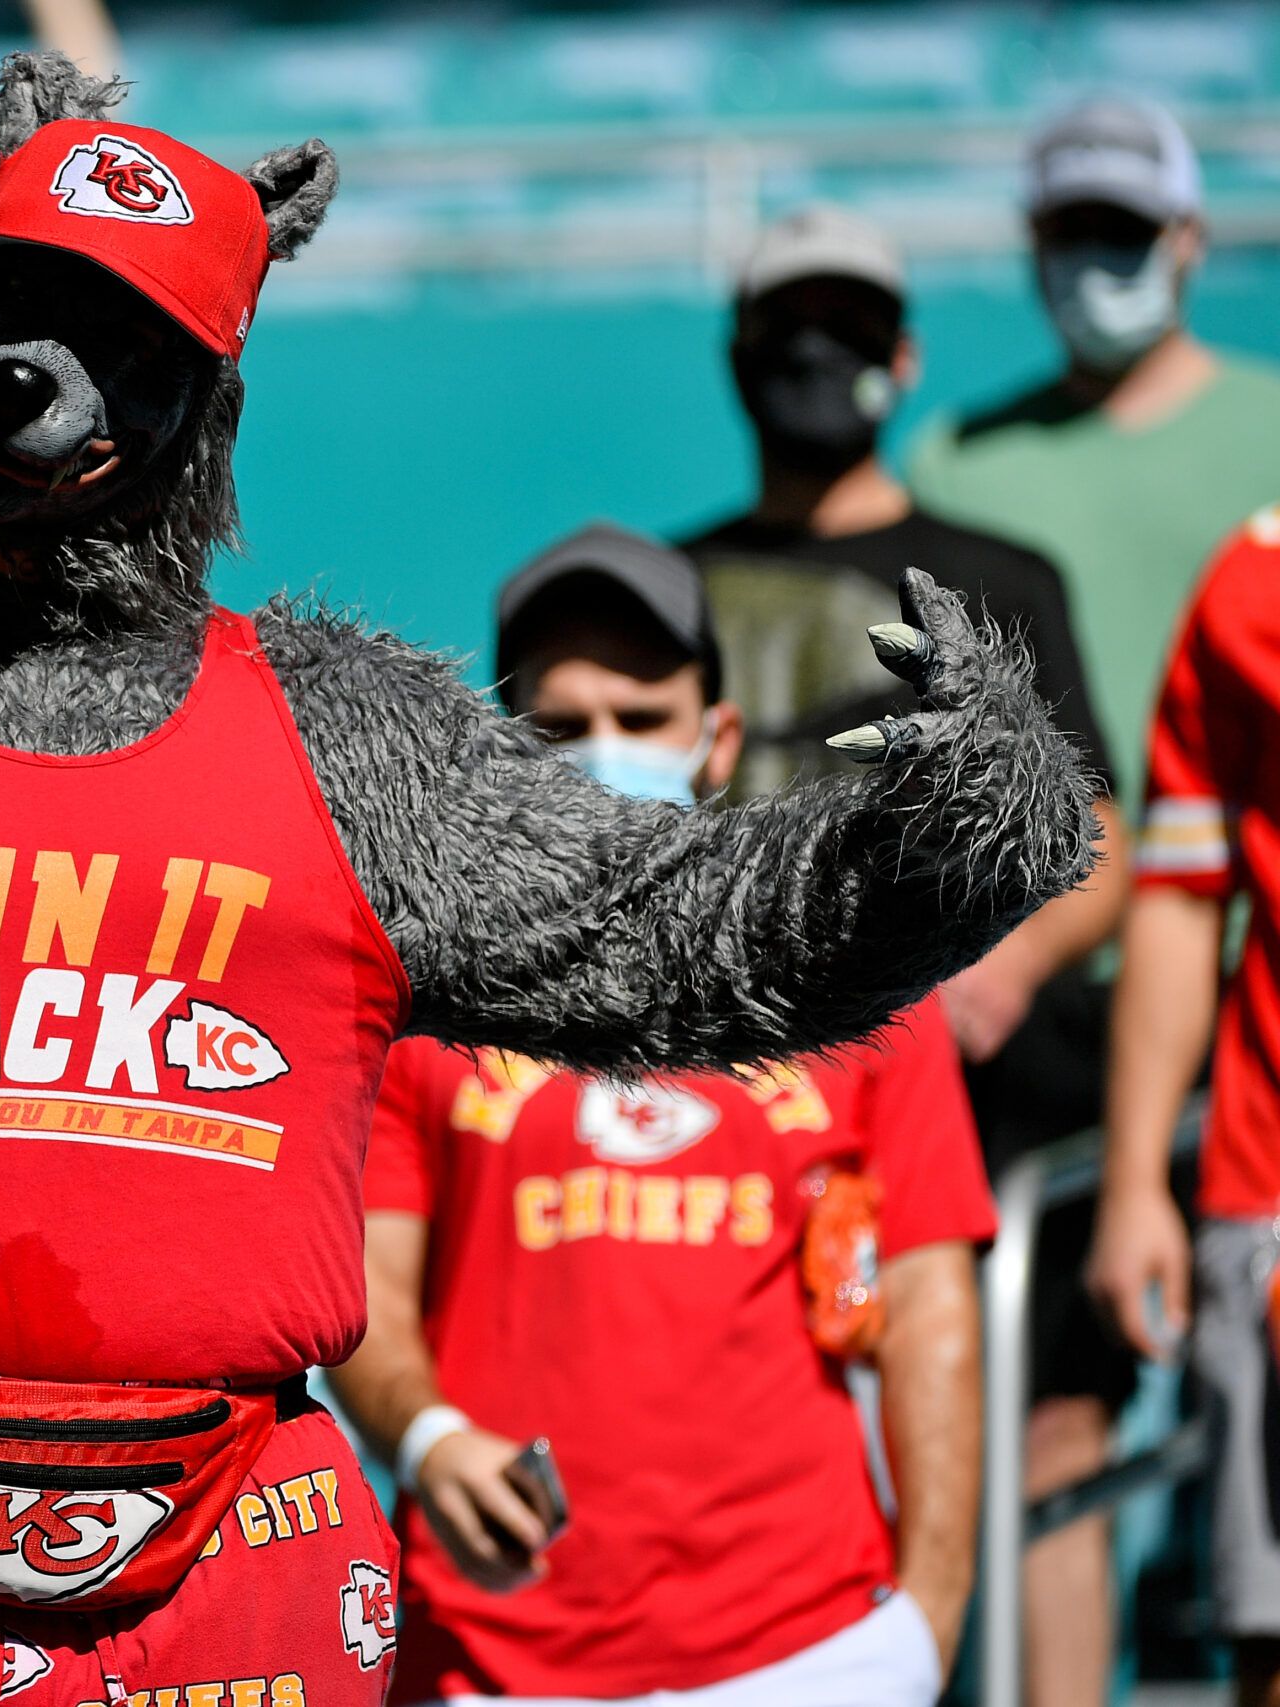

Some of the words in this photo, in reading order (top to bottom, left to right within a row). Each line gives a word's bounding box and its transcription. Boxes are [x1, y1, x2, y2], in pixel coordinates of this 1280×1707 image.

[86, 150, 169, 213] KC
[145, 857, 272, 983] IT
[195, 1022, 260, 1078] KC
[62, 1105, 106, 1132] IN
[122, 1111, 246, 1152] TAMPA
[513, 1165, 774, 1252] CHIEFS
[235, 1467, 343, 1549] CITY
